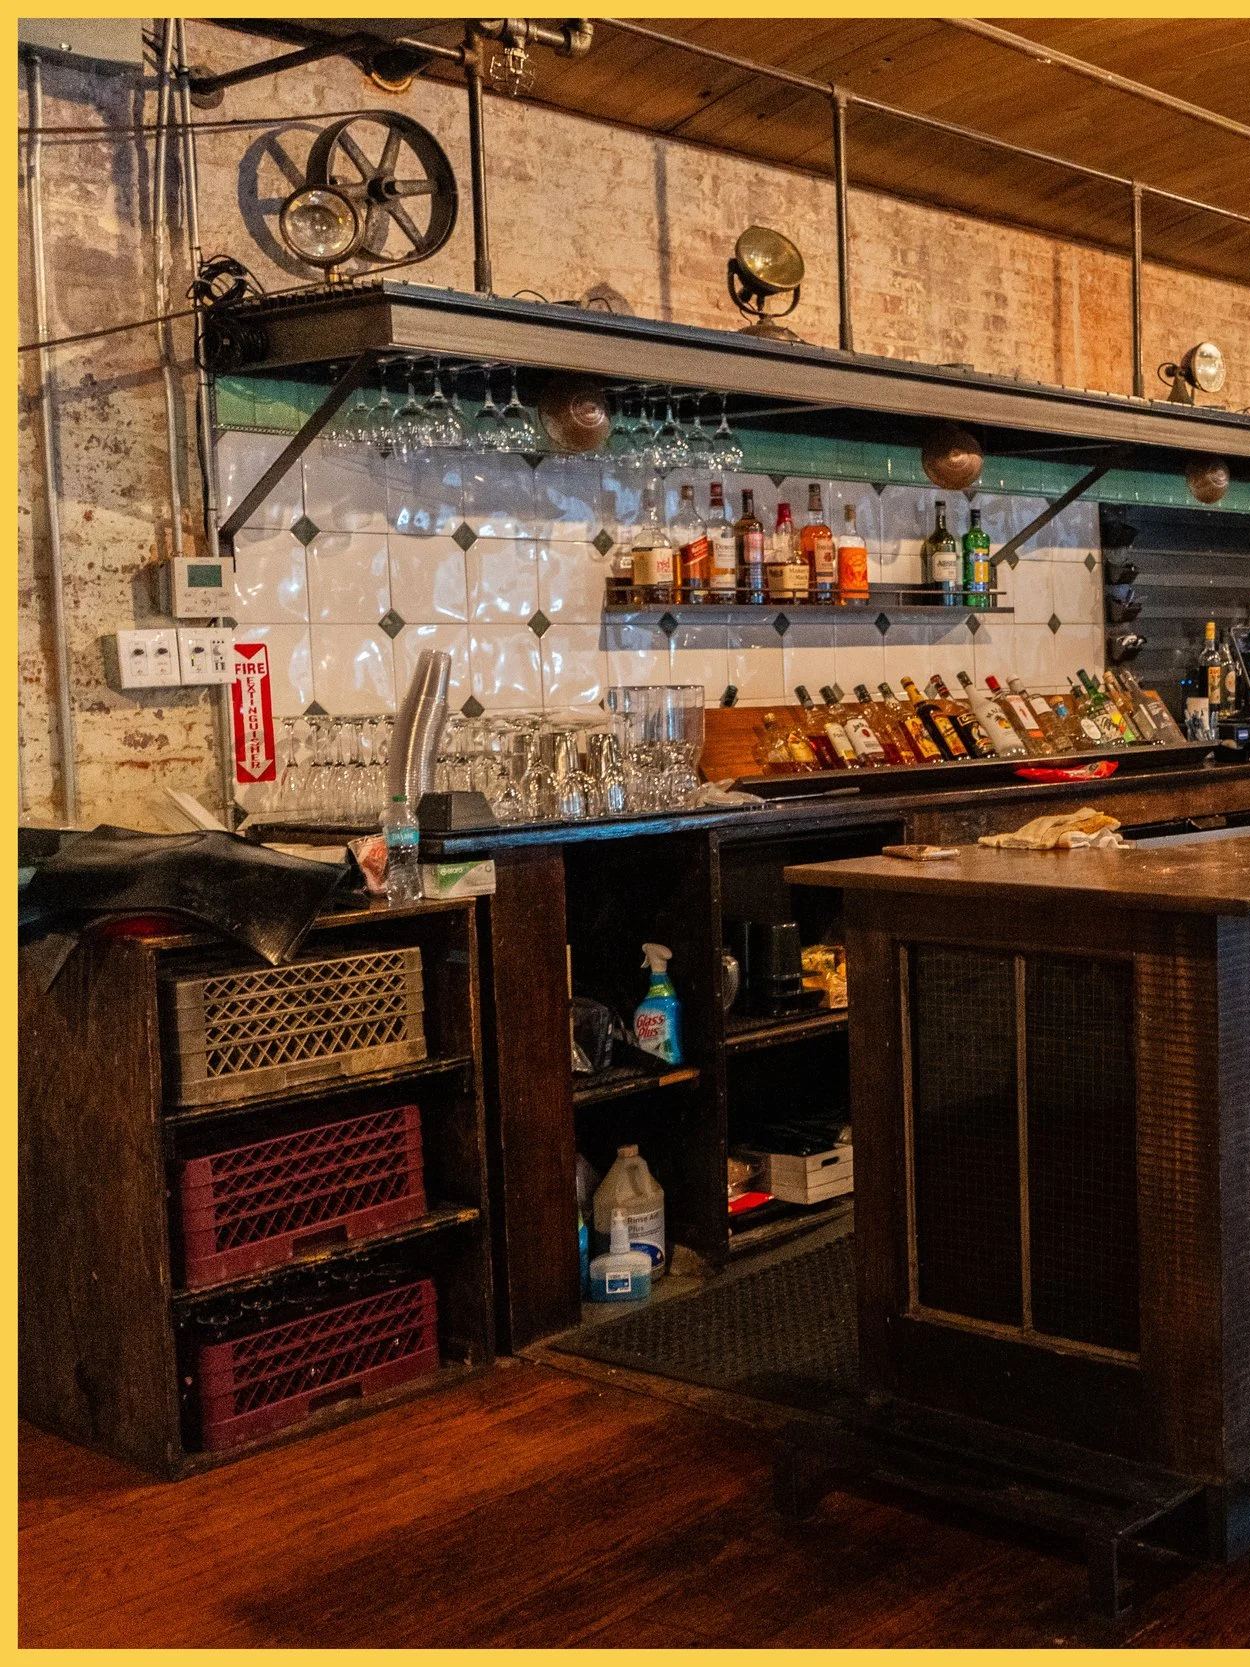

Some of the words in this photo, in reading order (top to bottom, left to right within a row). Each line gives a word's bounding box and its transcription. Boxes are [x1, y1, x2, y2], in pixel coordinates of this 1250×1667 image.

[235, 663, 265, 675] FIRE
[246, 677, 261, 769] EXTINGUISHER
[636, 1014, 665, 1028] Glass
[639, 1028, 658, 1038] Plus
[627, 1216, 648, 1224] Rinse
[628, 1225, 644, 1233] Plus
